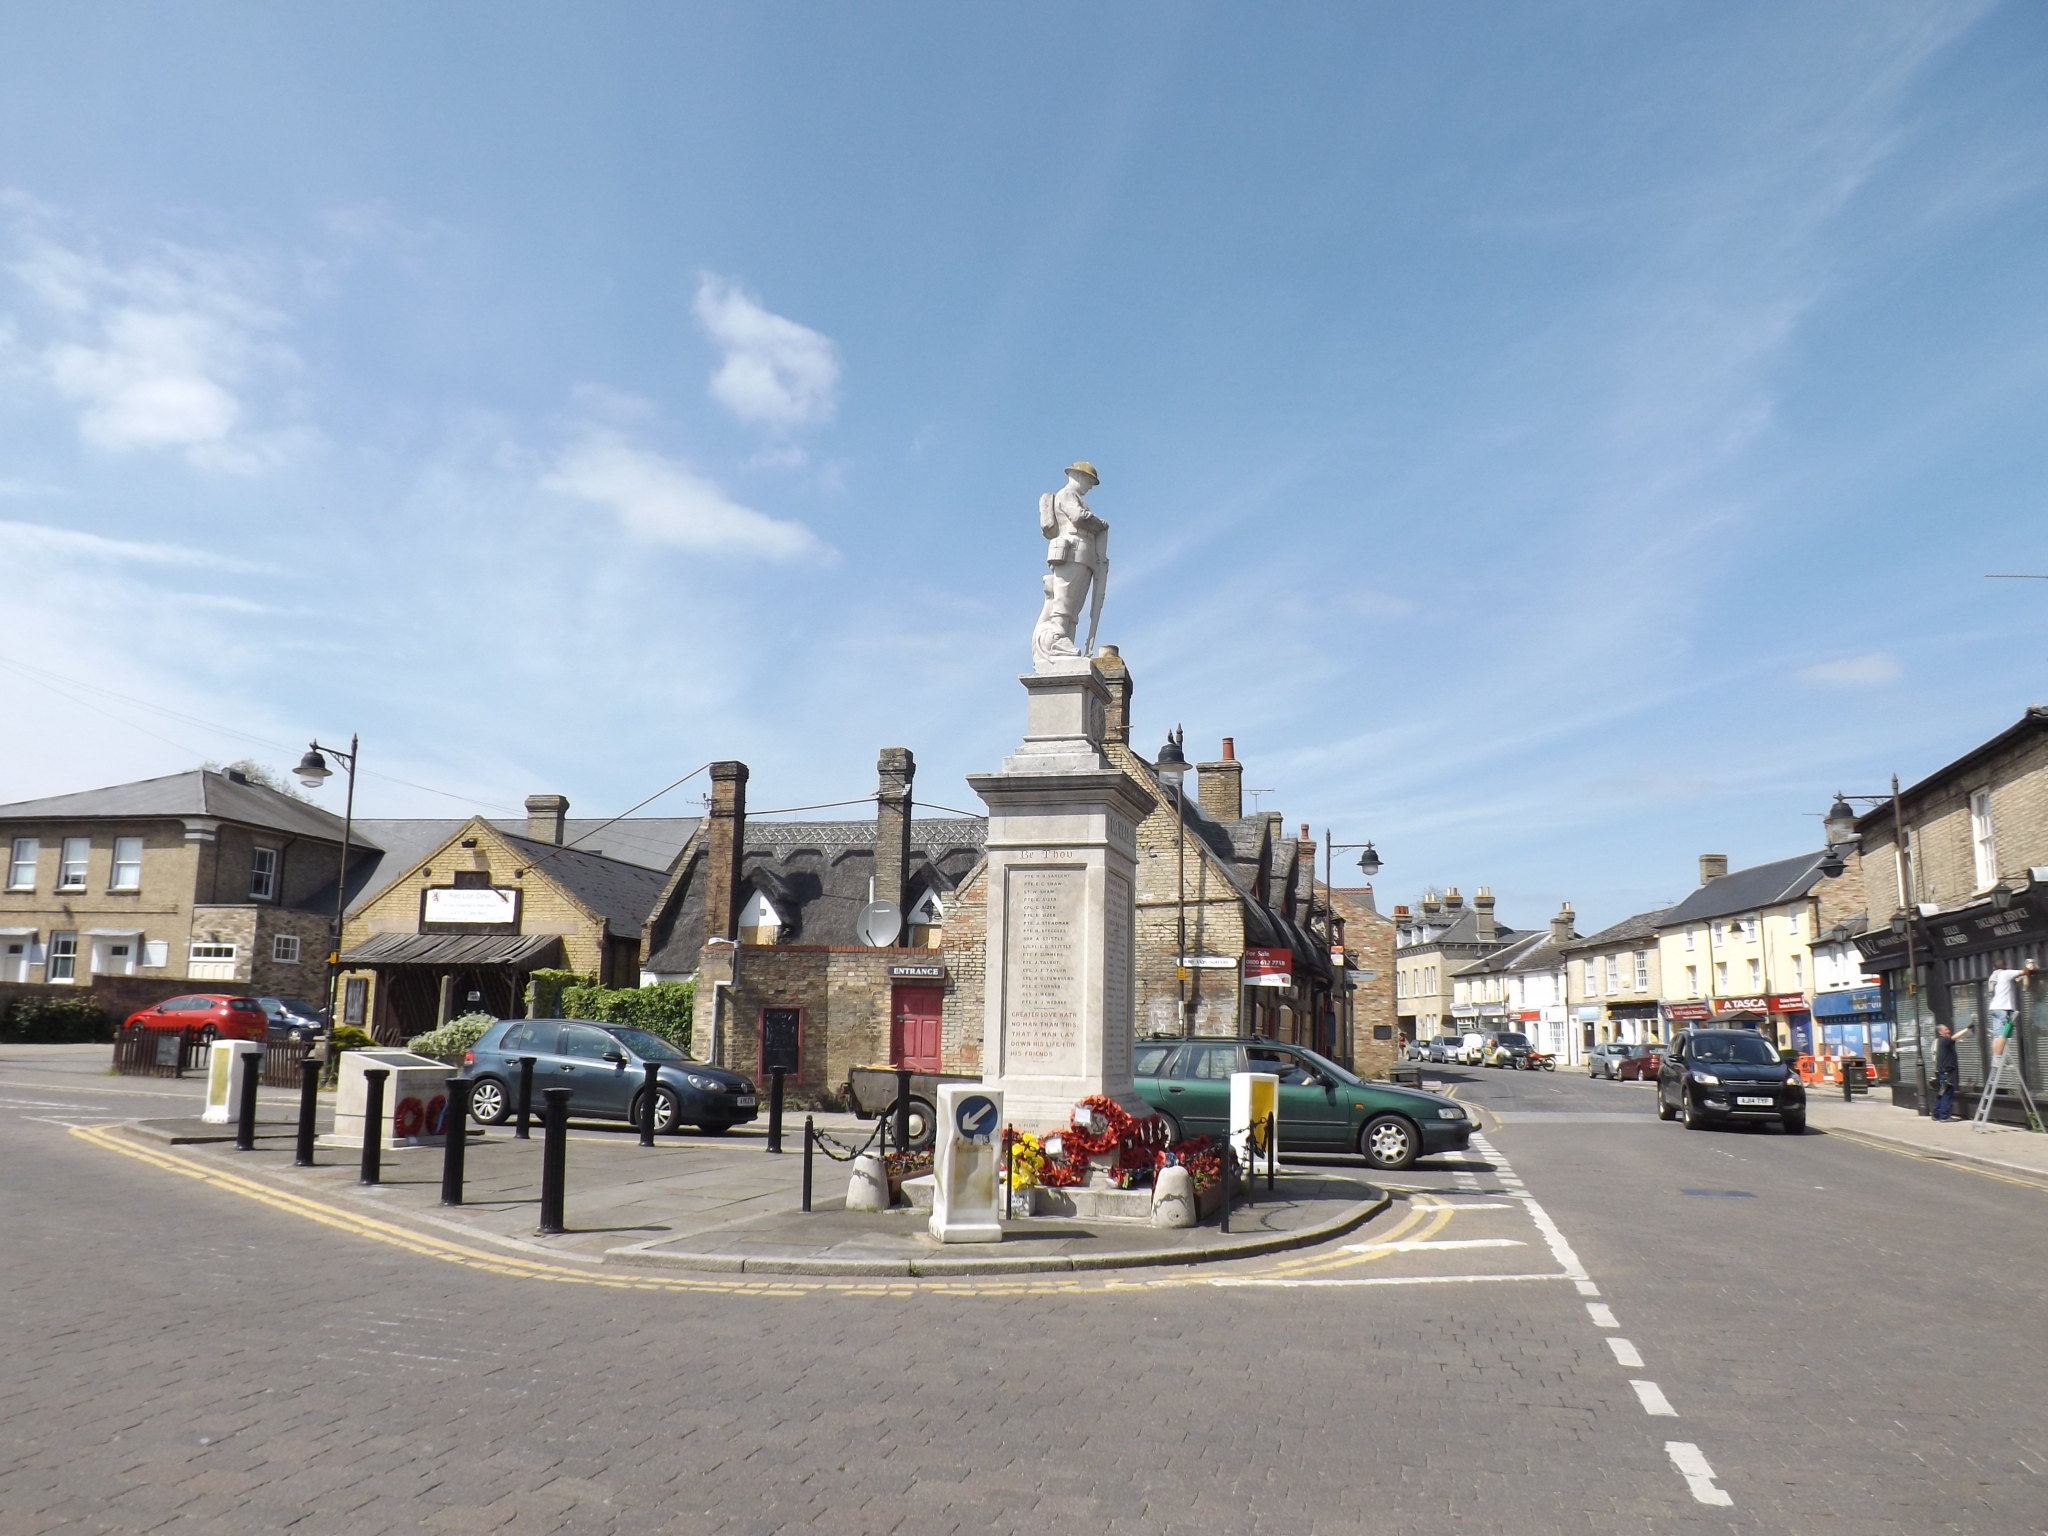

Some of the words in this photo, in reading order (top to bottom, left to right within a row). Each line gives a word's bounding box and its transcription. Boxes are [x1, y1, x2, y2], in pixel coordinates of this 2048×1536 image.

[1020, 850, 1034, 860] Be
[1042, 850, 1073, 859] Thou
[1942, 925, 1959, 936] FULLY
[1732, 999, 1766, 1008] TASCA
